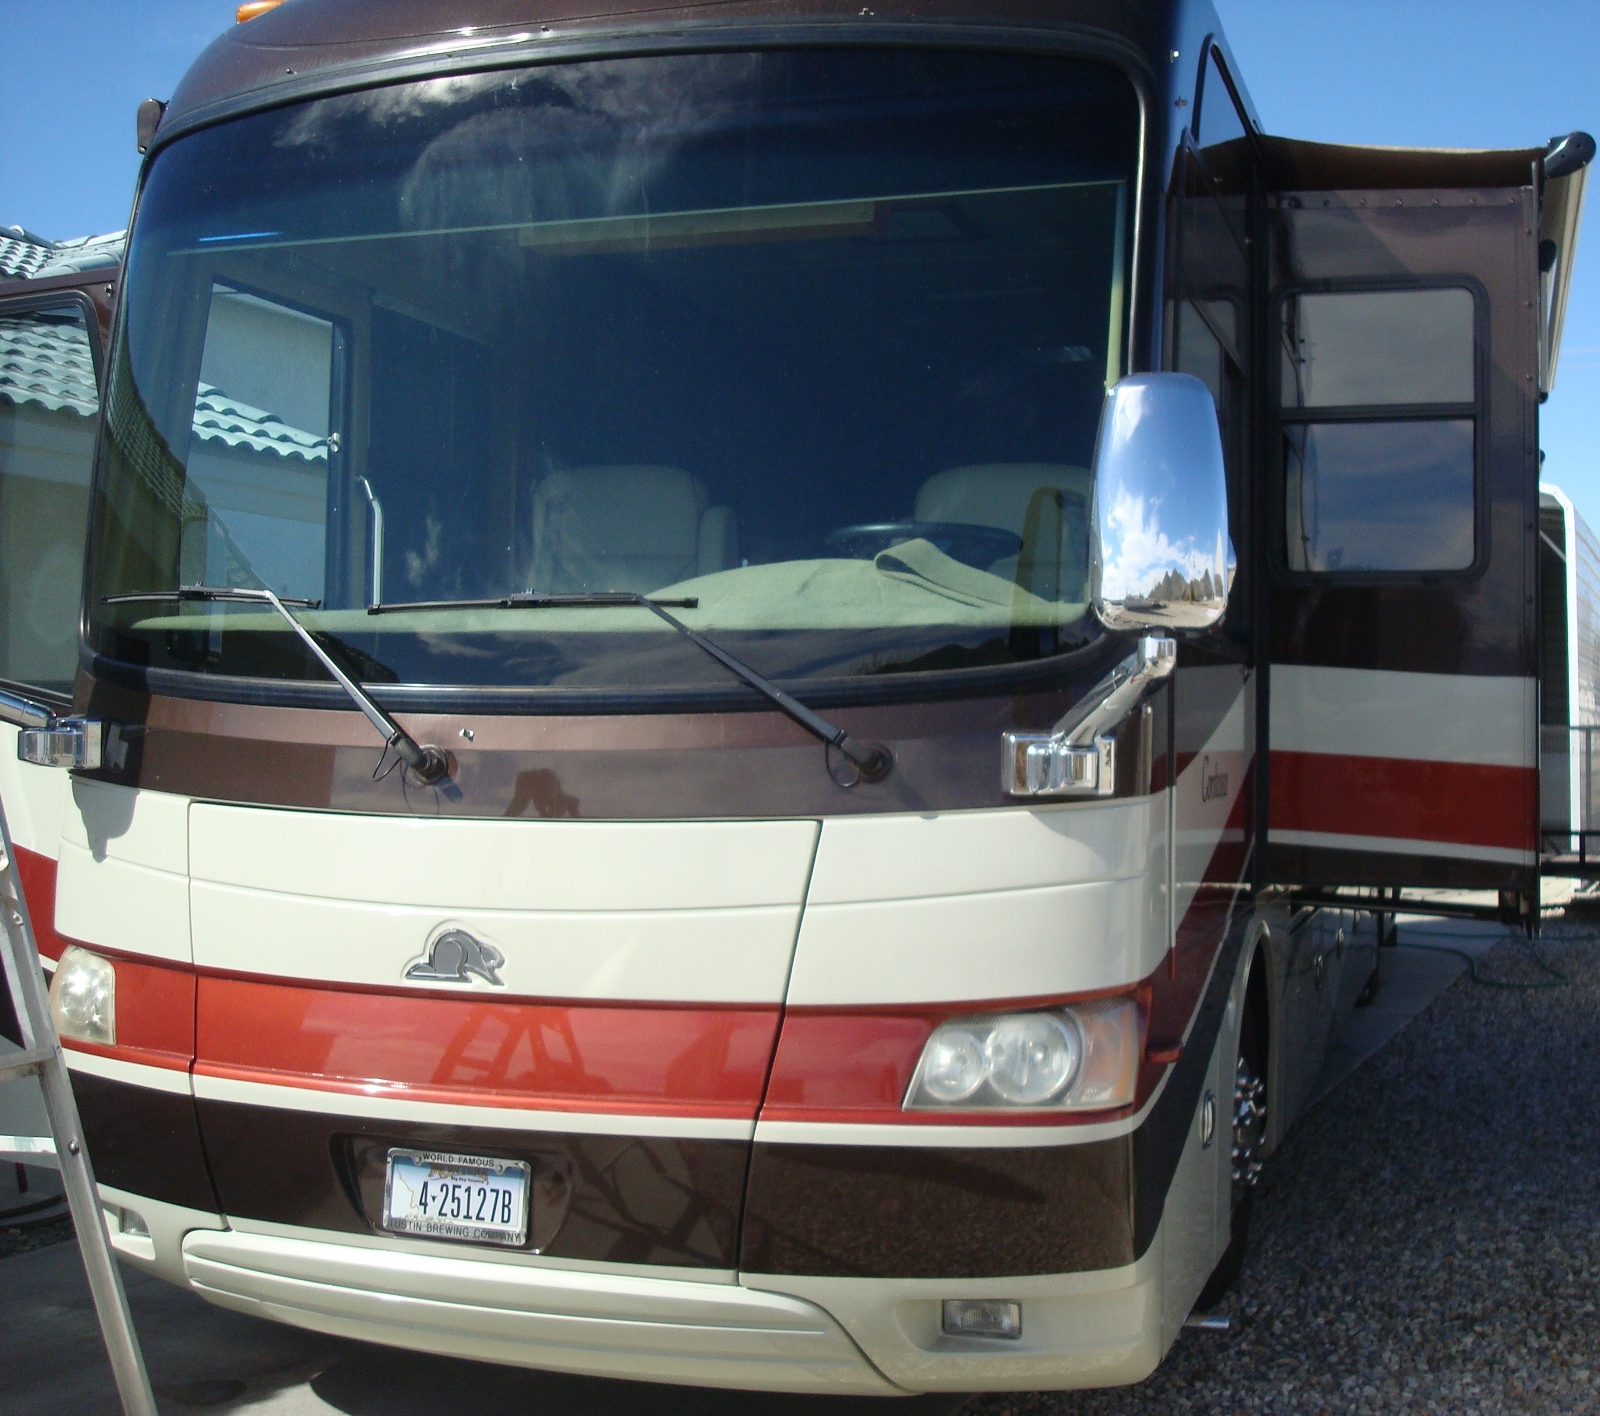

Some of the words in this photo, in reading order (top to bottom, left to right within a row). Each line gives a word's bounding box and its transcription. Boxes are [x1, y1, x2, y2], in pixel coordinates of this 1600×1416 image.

[422, 1152, 454, 1164] WORLD
[458, 1157, 495, 1167] FAMOUS
[426, 1223, 469, 1237] BREWING
[473, 1228, 520, 1243] COMPANY
